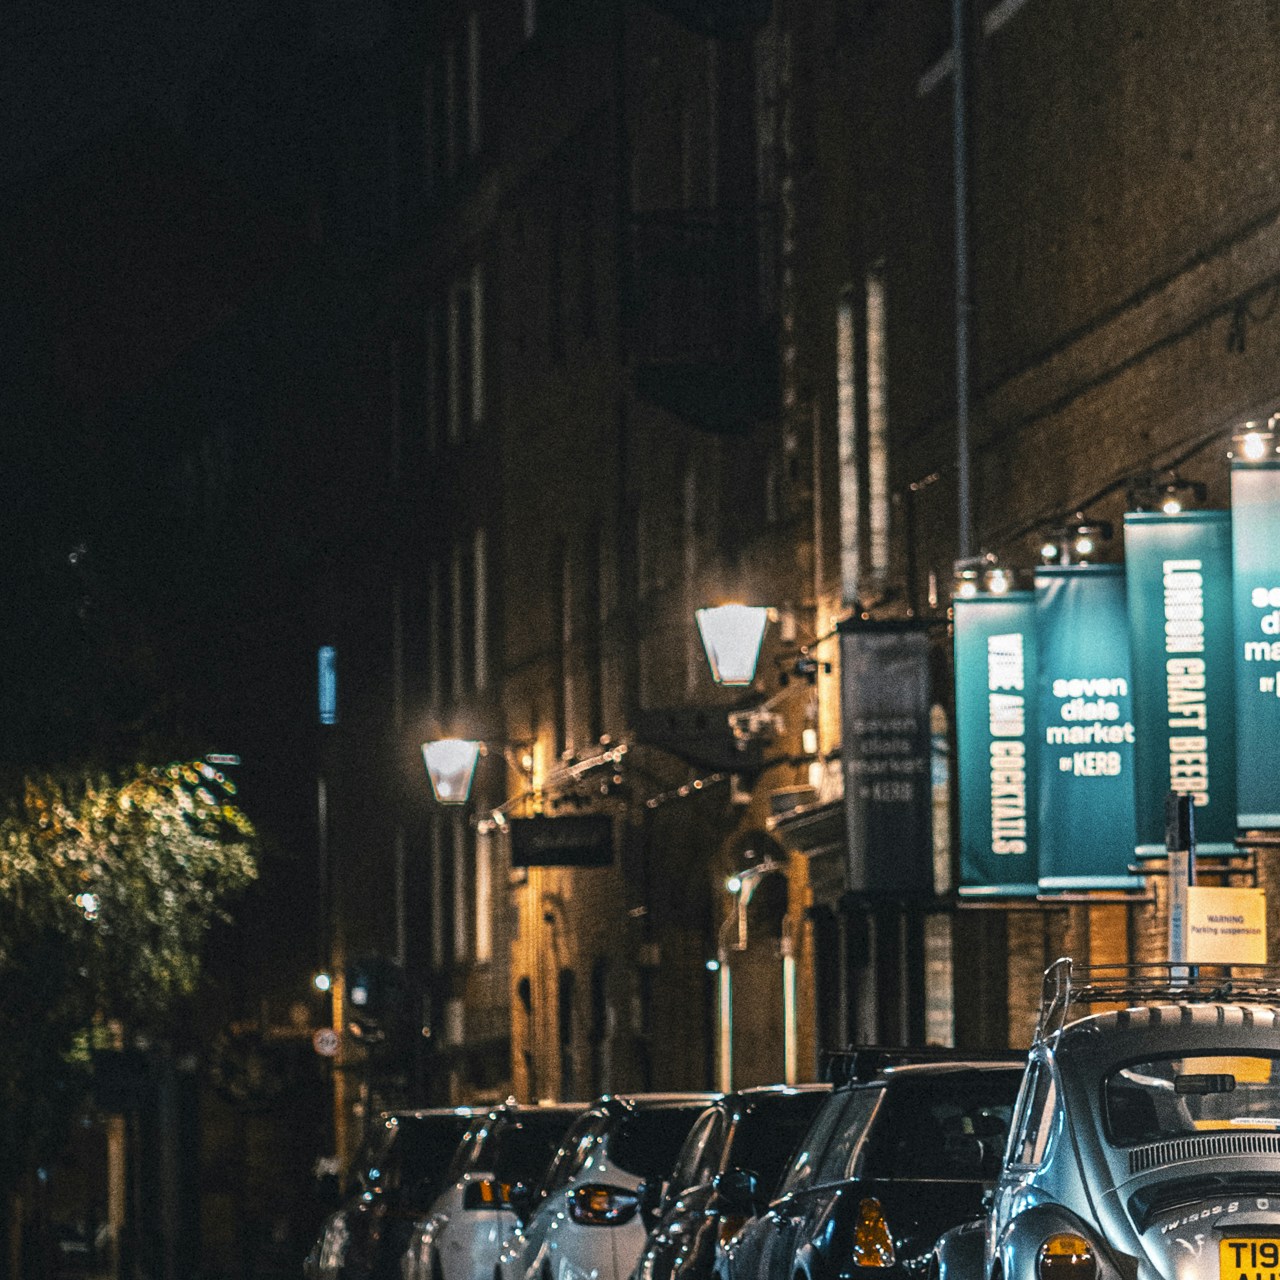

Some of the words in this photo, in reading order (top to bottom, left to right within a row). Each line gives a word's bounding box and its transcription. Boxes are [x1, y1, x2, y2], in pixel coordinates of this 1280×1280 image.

[1162, 559, 1205, 653] LONDON
[1052, 677, 1128, 698] seven
[1166, 658, 1207, 730] CRAFT
[988, 693, 1025, 737] AND
[1060, 698, 1120, 721] dials
[1046, 722, 1136, 744] market
[1073, 751, 1121, 776] KERB
[989, 740, 1027, 854] COCKTAILS
[1191, 926, 1218, 935] Parking
[1221, 927, 1262, 935] suspension
[1207, 915, 1244, 924] WARNING
